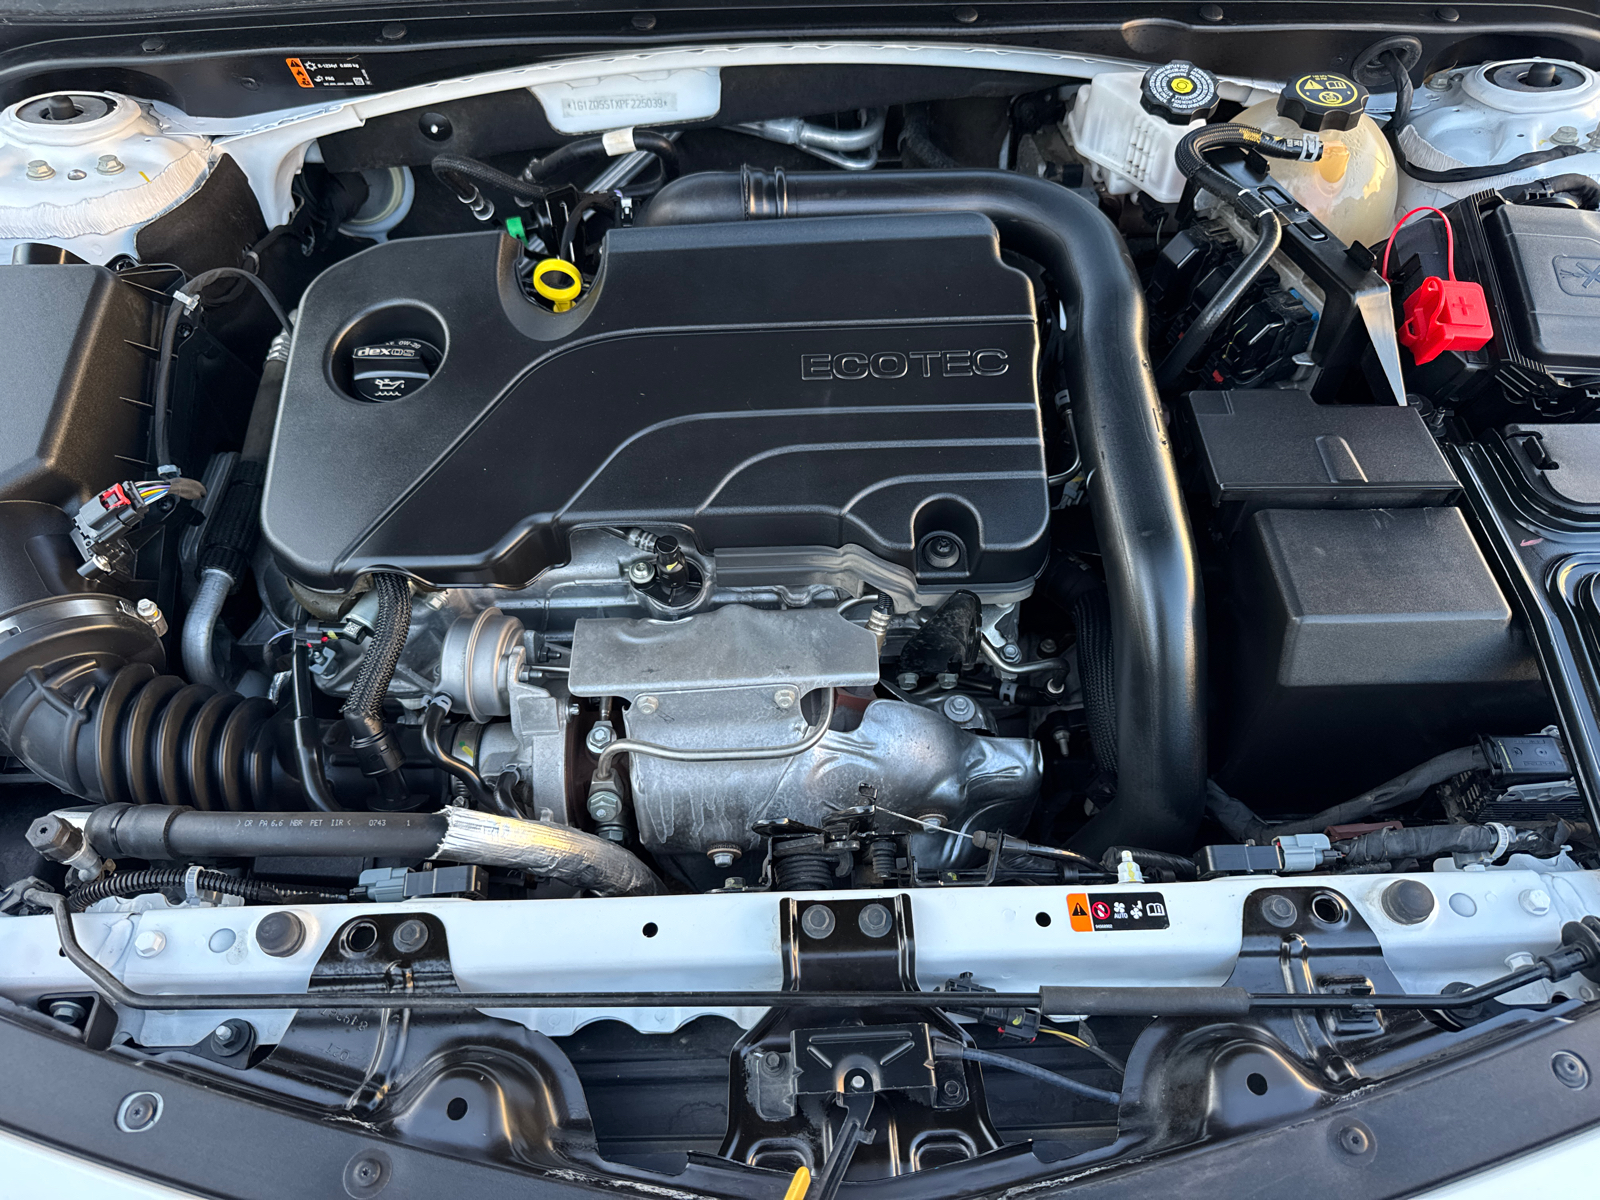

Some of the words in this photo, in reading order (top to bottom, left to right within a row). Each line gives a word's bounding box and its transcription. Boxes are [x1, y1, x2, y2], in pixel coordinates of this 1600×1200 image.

[357, 347, 416, 357] dexos
[801, 348, 1009, 381] ECOTEC
[309, 819, 324, 827] PET
[368, 819, 387, 827] 0743
